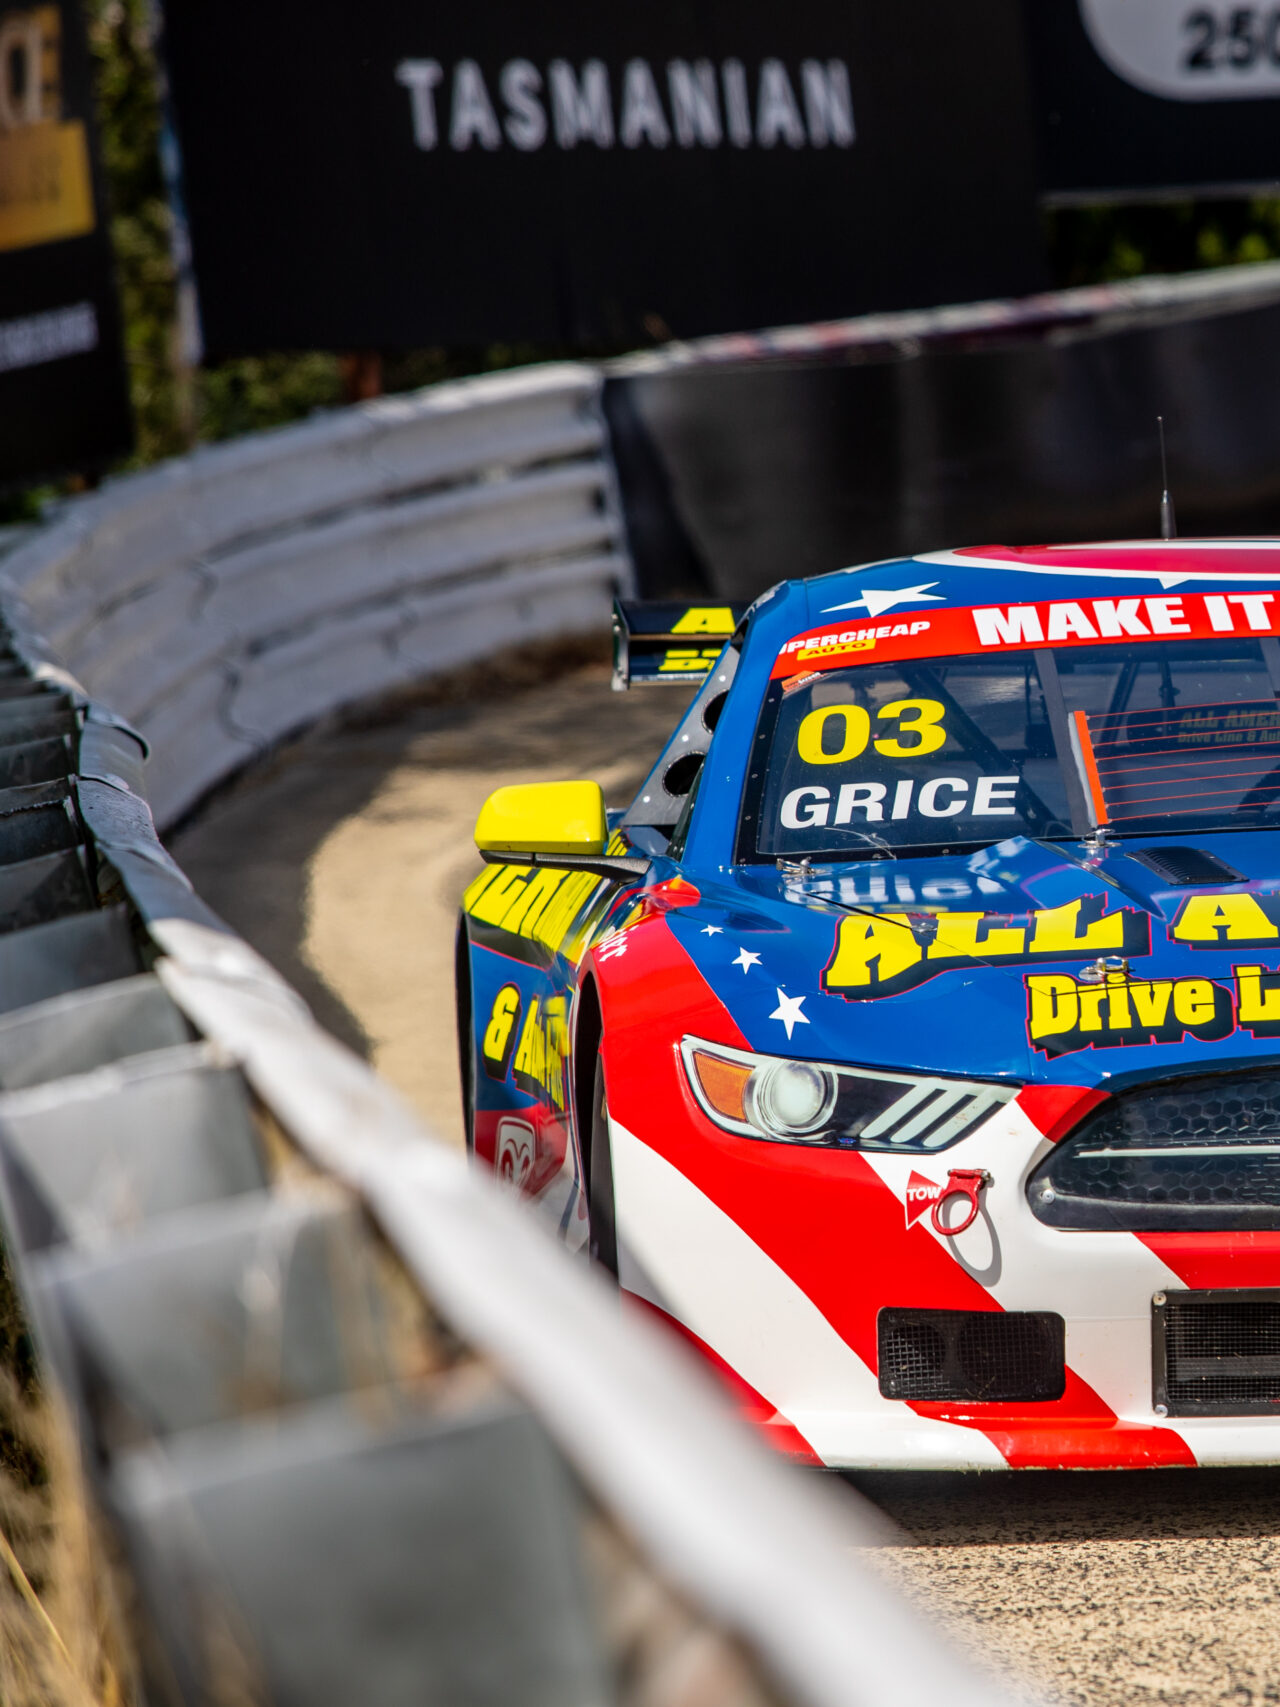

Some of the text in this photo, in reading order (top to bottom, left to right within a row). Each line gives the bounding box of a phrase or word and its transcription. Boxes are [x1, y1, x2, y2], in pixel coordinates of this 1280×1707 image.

[398, 58, 856, 150] TASMANIAN
[806, 642, 866, 656] AUTO
[973, 597, 1191, 646] MAKE
[1204, 593, 1276, 632] IT
[797, 699, 946, 765] 03
[780, 776, 1020, 829] GRICE
[825, 898, 1125, 988] ALL
[1030, 973, 1216, 1039] Drive
[907, 1186, 941, 1201] TOW
